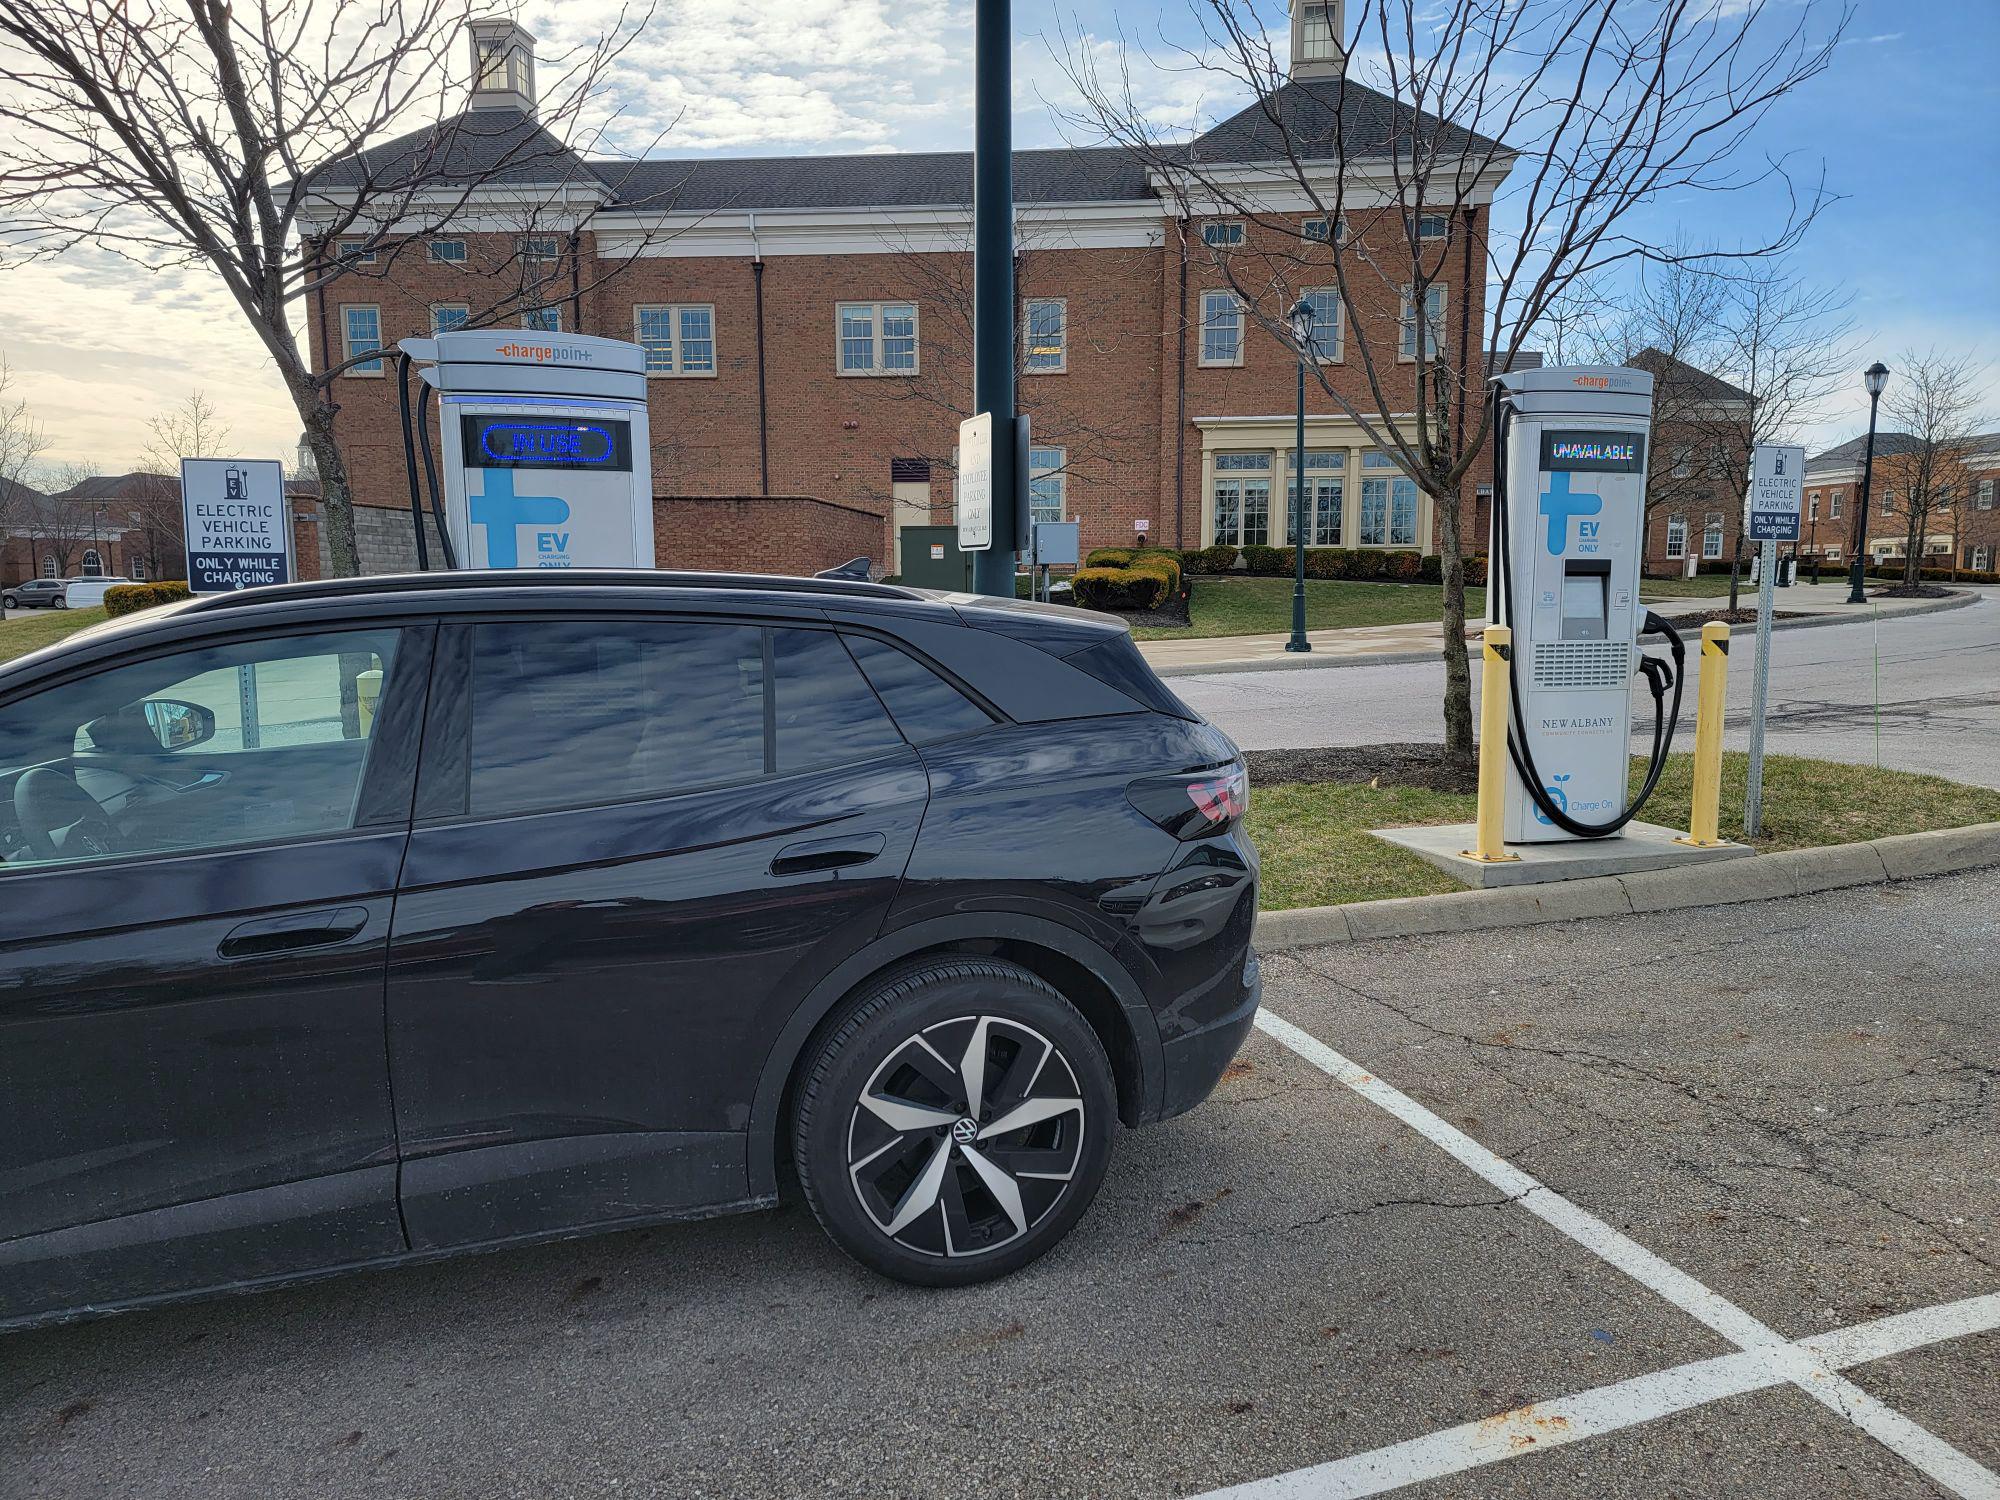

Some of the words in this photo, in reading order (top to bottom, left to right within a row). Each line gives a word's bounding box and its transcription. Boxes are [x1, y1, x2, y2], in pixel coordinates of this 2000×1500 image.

[513, 434, 534, 452] IN
[540, 434, 581, 452] USE
[1553, 443, 1634, 460] UNAVAILABLE
[1758, 478, 1797, 488] ELECTRIC
[963, 488, 986, 502] PARKING
[1760, 489, 1794, 499] VEHICLE
[196, 504, 273, 518] ELECTRIC
[1758, 500, 1794, 510] PARKING
[1136, 521, 1148, 529] FDC
[1754, 515, 1774, 524] ONLY
[1775, 516, 1796, 525] WHILE
[202, 520, 269, 533] VEHICLE
[1579, 521, 1600, 537] EV
[1756, 525, 1793, 535] CHARGING
[202, 536, 272, 549] PARKING
[537, 532, 570, 552] EV
[1578, 544, 1599, 552] ONLY
[196, 557, 234, 570] ONLY
[238, 558, 280, 570] WHILE
[203, 571, 275, 583] CHARGING
[1542, 719, 1568, 729] NEW
[1570, 717, 1613, 728] ALBANY
[1571, 801, 1600, 811] Charge
[1601, 800, 1613, 808] On
